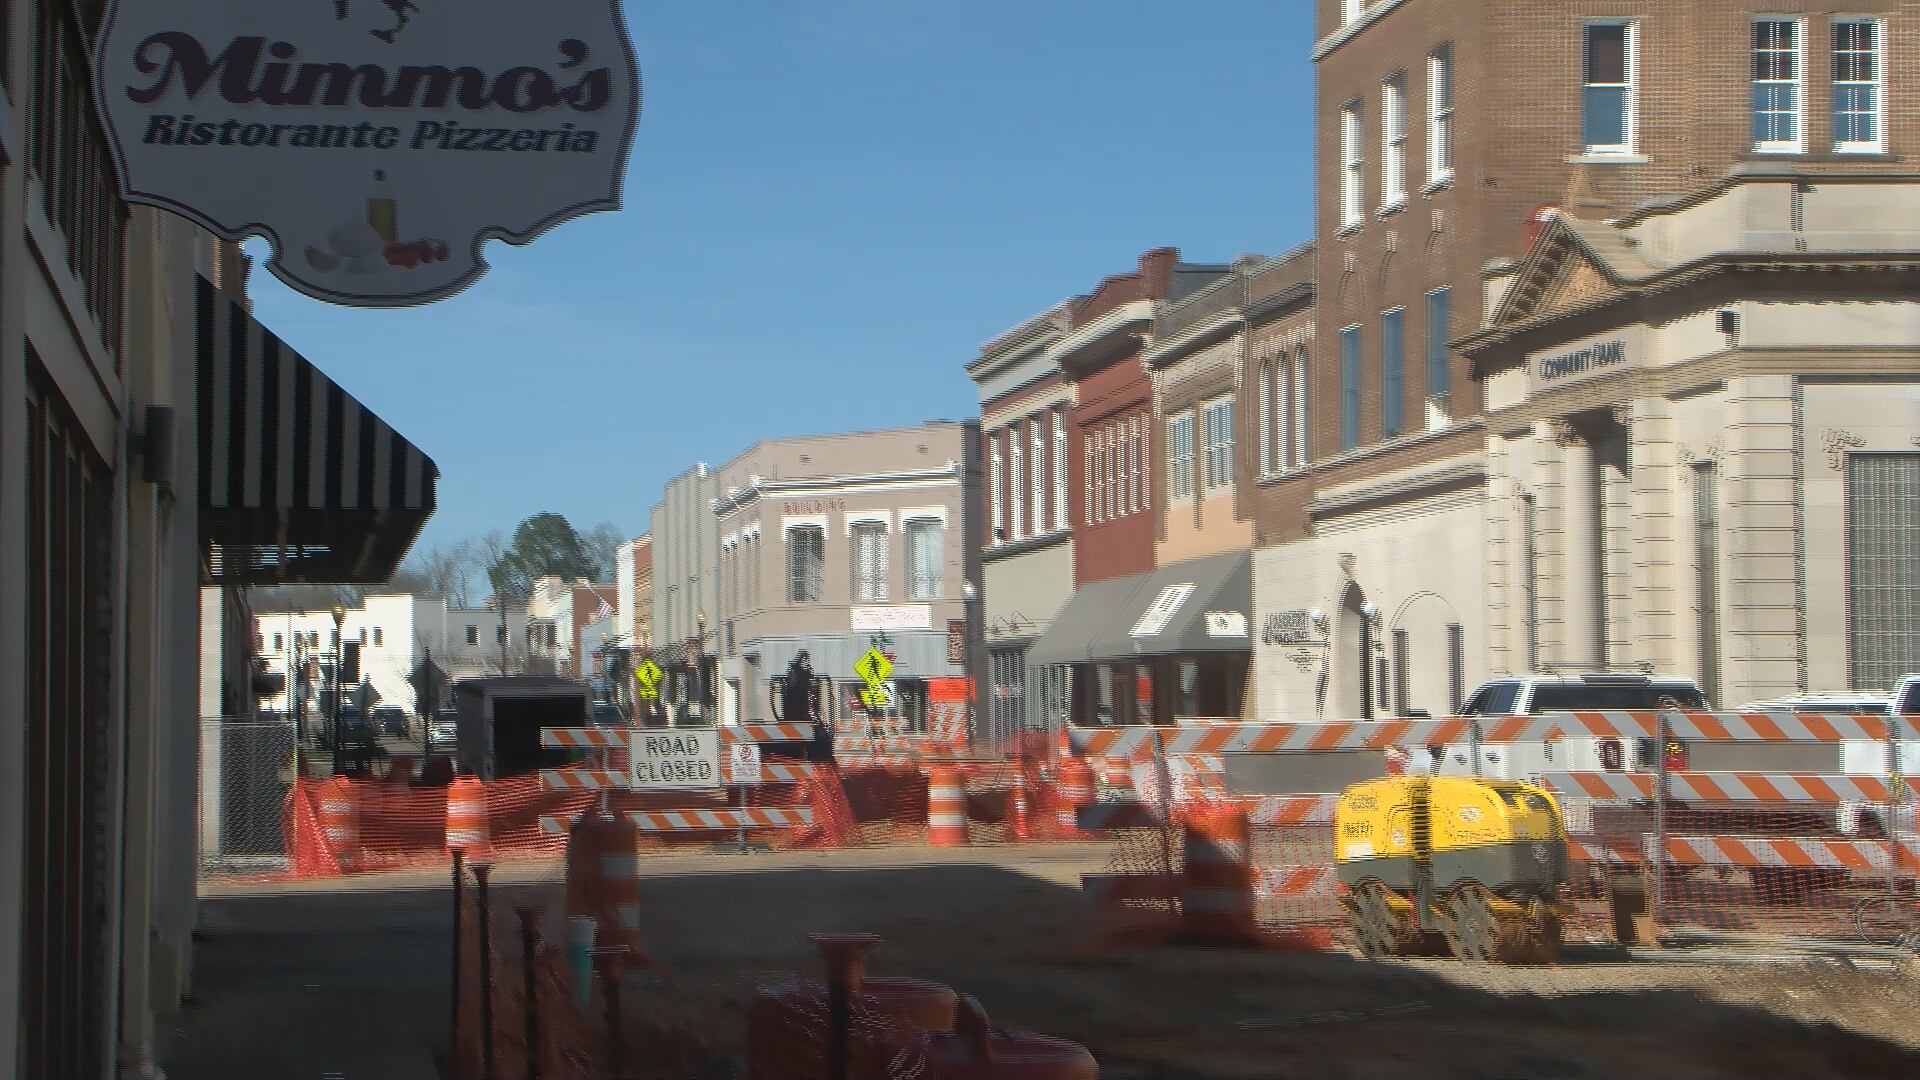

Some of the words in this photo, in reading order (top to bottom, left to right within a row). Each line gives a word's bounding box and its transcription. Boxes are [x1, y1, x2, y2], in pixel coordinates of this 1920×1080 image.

[125, 31, 612, 113] Mimmo's
[143, 114, 400, 149] Ristorante
[409, 120, 598, 153] Pizzeria
[1593, 341, 1626, 368] BANK
[784, 498, 846, 515] BUILDING
[646, 735, 700, 758] ROAD
[636, 760, 712, 783] CLOSED
